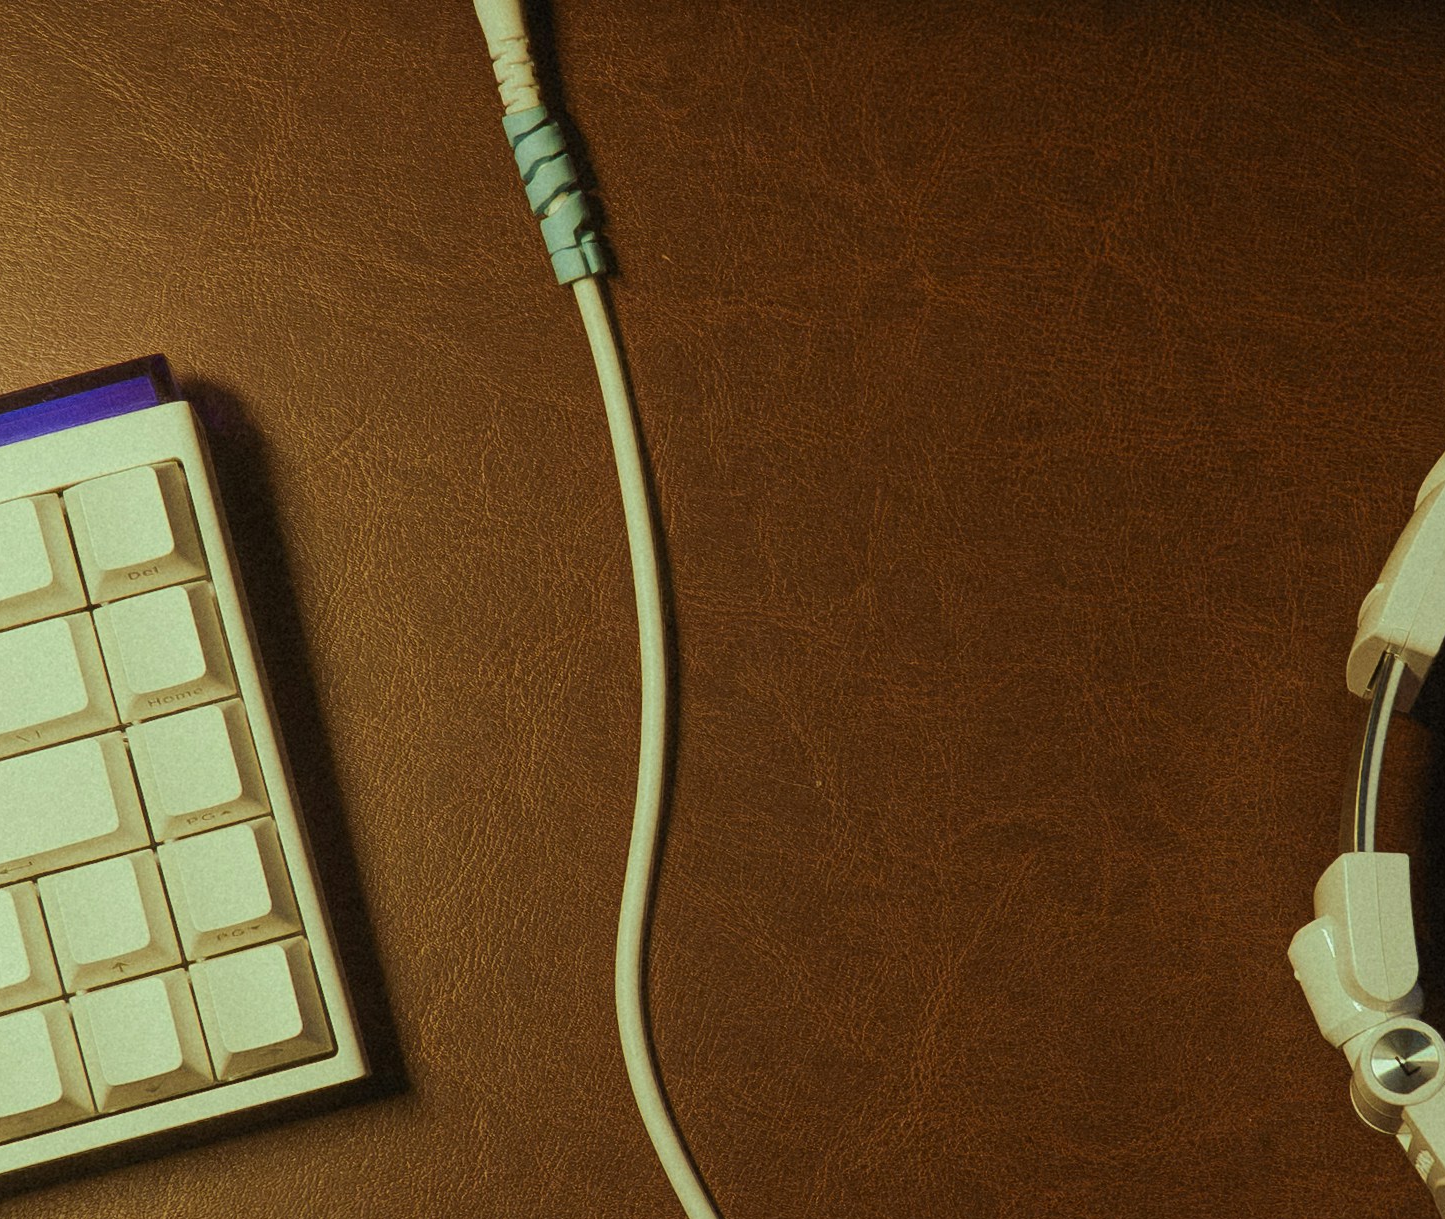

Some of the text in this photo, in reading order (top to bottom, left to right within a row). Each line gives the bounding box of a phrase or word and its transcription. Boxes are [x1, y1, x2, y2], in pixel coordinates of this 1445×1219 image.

[127, 566, 160, 581] Del
[147, 686, 203, 708] Home
[1394, 1055, 1422, 1076] L
